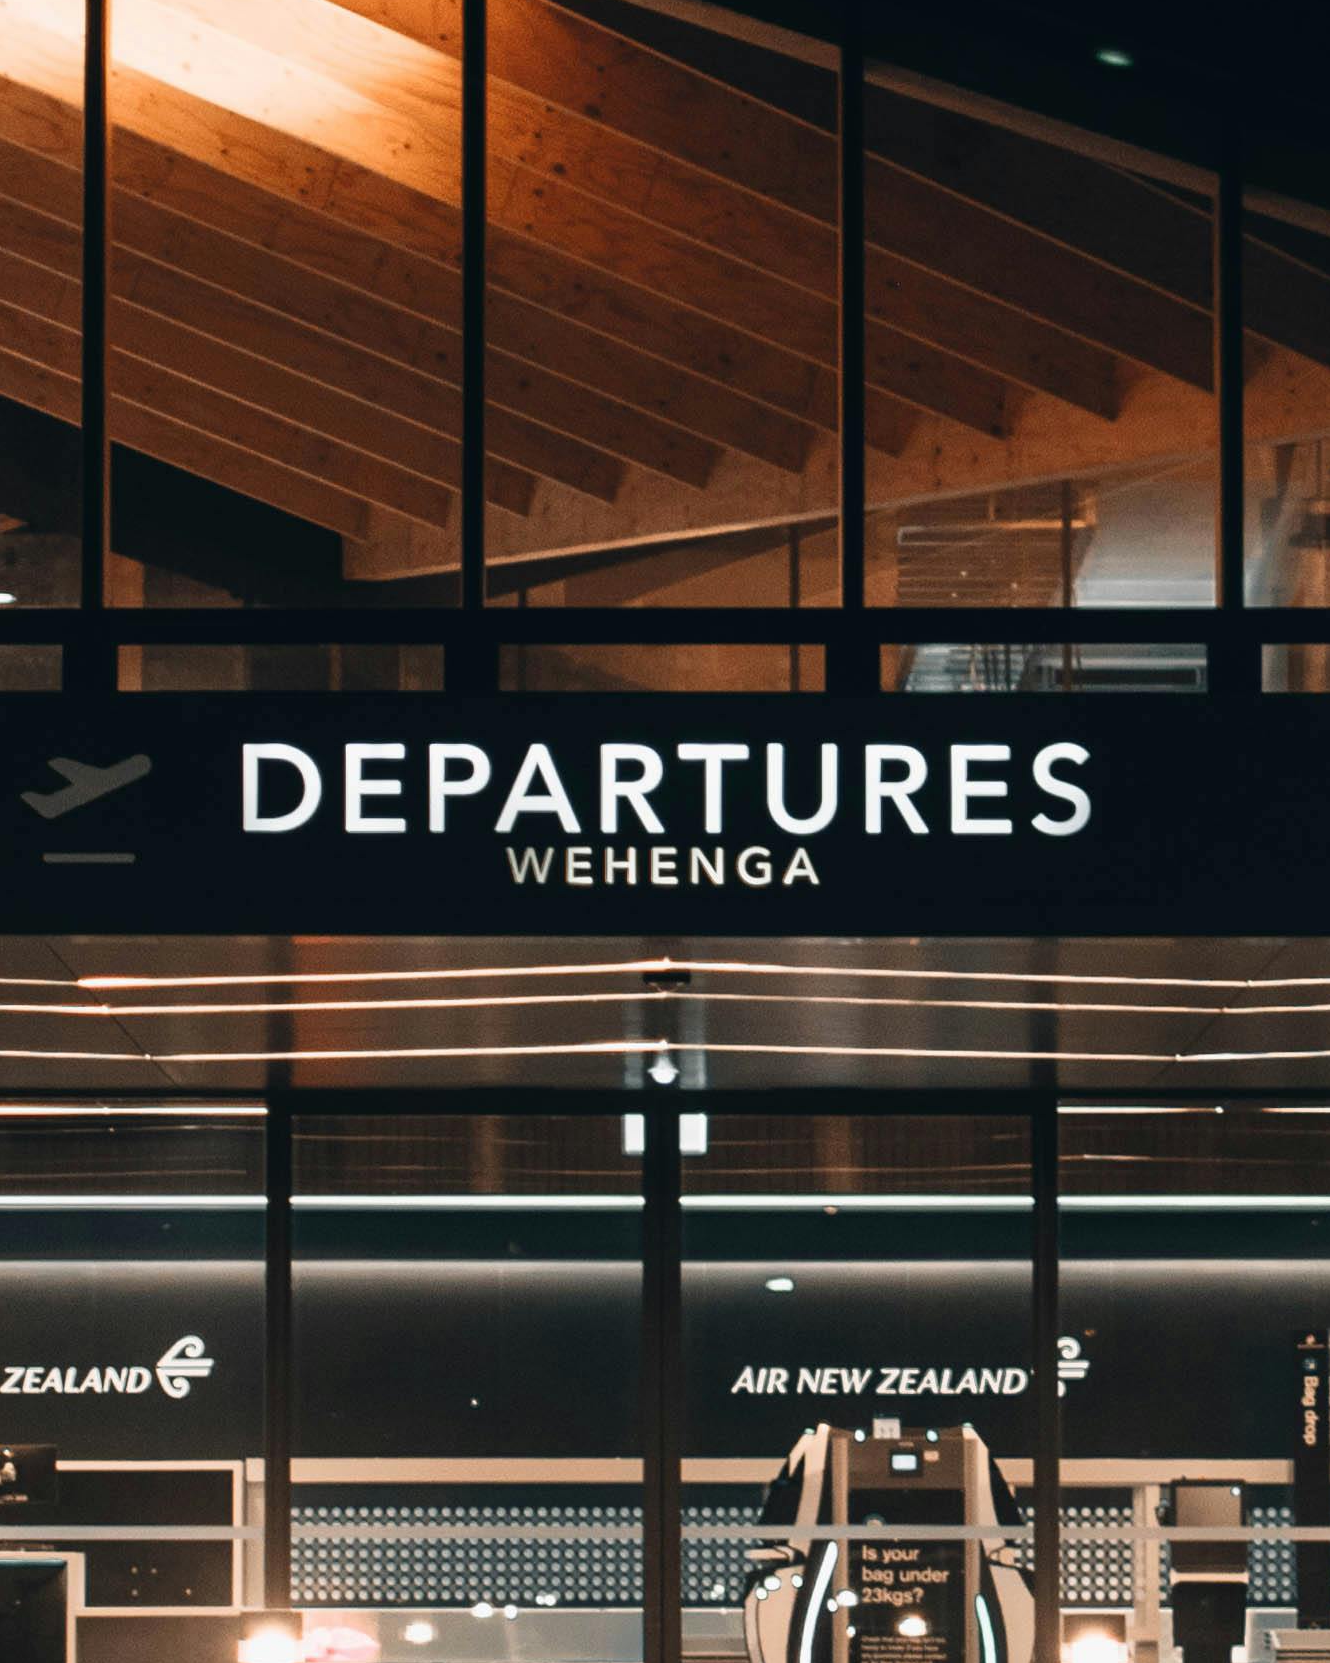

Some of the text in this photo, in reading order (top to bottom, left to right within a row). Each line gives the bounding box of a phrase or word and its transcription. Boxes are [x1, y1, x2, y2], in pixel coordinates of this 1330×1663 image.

[241, 742, 1092, 838] DEPARTURES
[505, 846, 820, 886] WEHENGA
[0, 1366, 152, 1394] ZEALAND
[730, 1365, 1028, 1395] AIR NEW ZEALAND
[1302, 1376, 1320, 1445] Bag drop
[862, 1544, 920, 1564] Is your
[862, 1565, 949, 1586] bag under
[862, 1587, 925, 1607] 23kgs?
